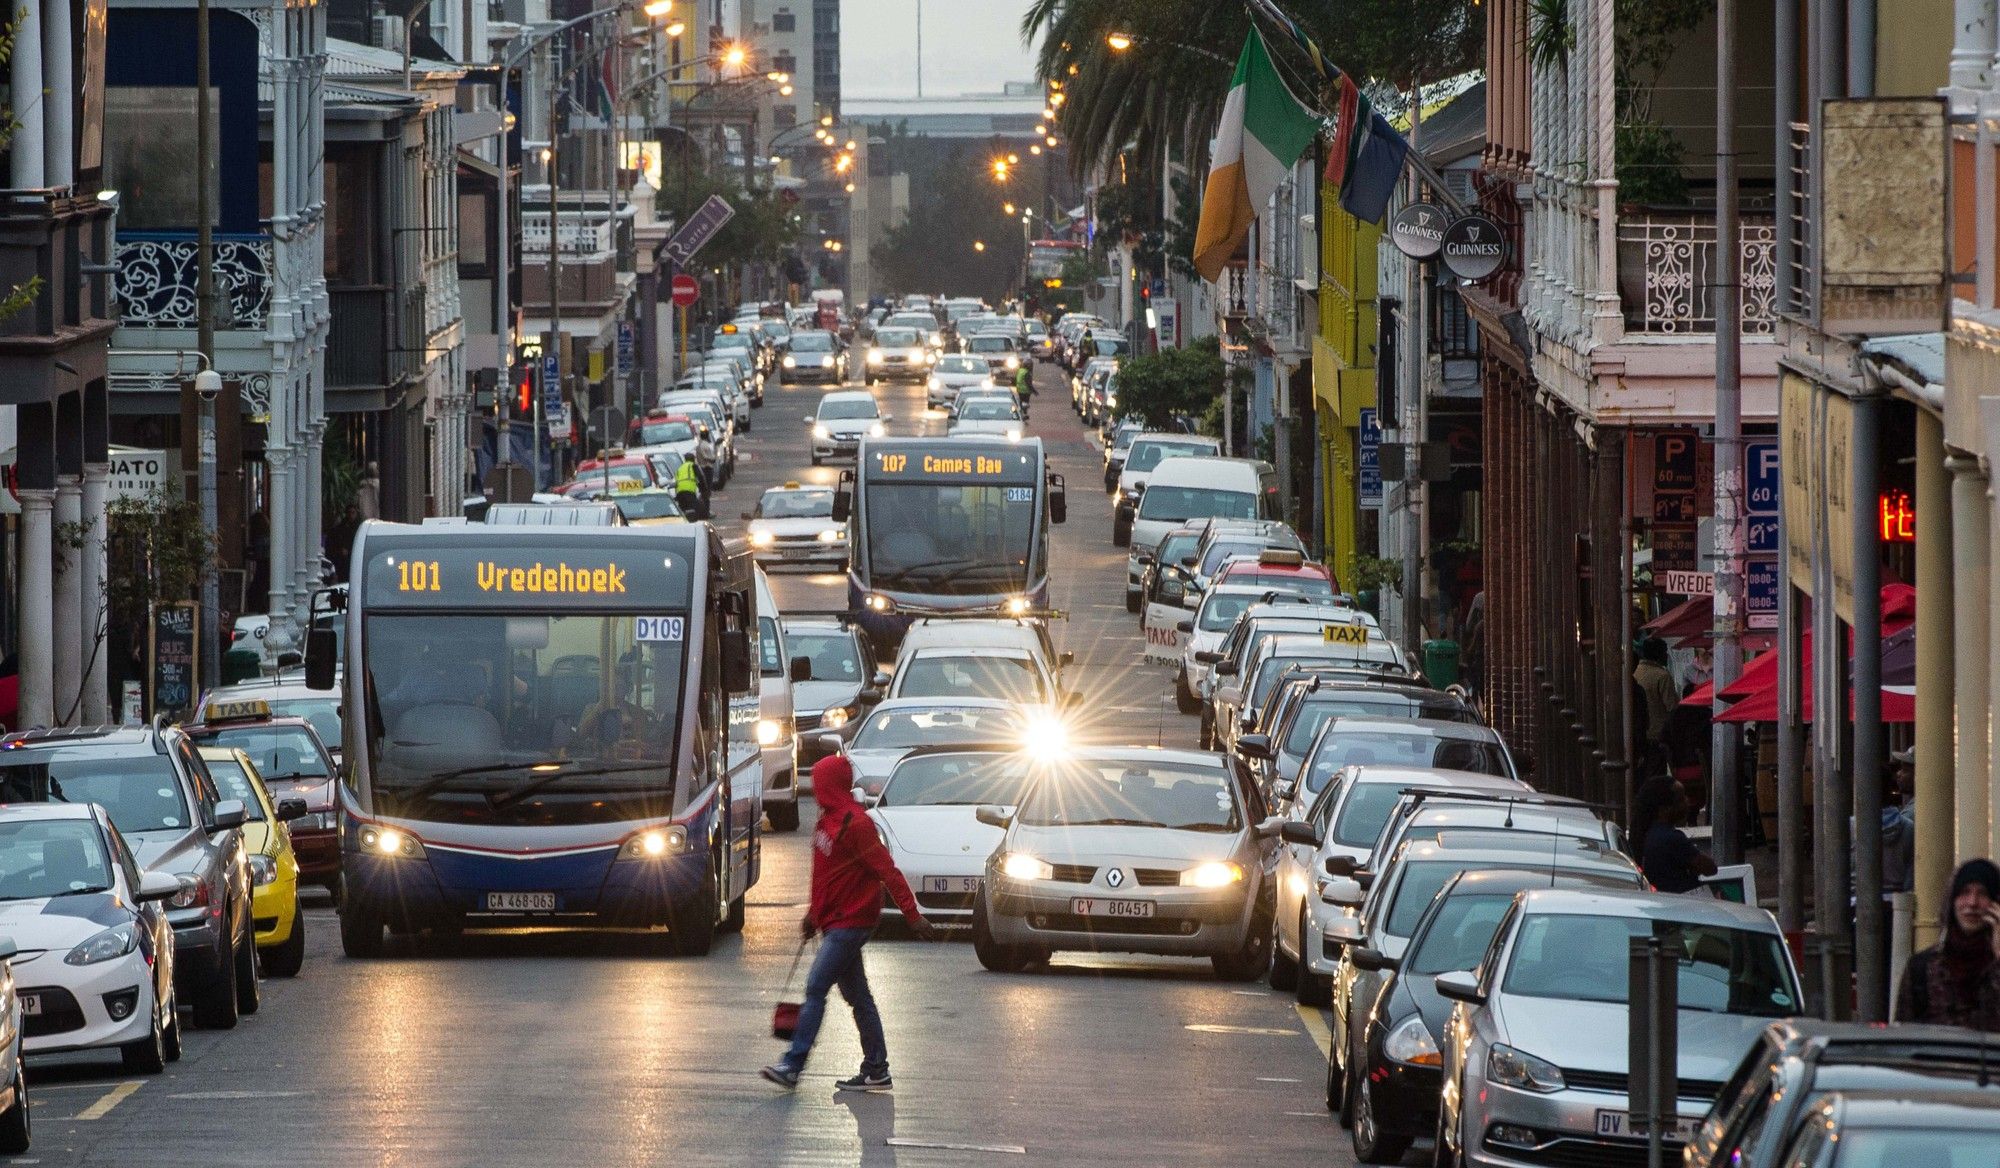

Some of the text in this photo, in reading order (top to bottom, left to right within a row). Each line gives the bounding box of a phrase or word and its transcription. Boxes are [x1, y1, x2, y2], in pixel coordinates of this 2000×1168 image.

[1396, 222, 1443, 242] GUINNESS
[1446, 242, 1500, 256] GUINNESS
[546, 358, 555, 369] P
[1666, 438, 1685, 463] P
[881, 454, 1002, 474] 107 Camps Bay
[1658, 470, 1693, 482] 60 min
[1008, 490, 1031, 500] D184
[1752, 487, 1770, 501] 60
[398, 560, 627, 593] 101 Vredehoek
[1668, 574, 1713, 593] VREDE
[637, 618, 682, 639] D109
[1327, 626, 1367, 643] TAXI
[1146, 627, 1177, 647] TAXIS
[217, 702, 257, 717] TAXI
[934, 878, 948, 891] ND
[489, 894, 504, 907] CA
[1077, 900, 1149, 916] CY 80451
[1601, 1114, 1621, 1133] DV
